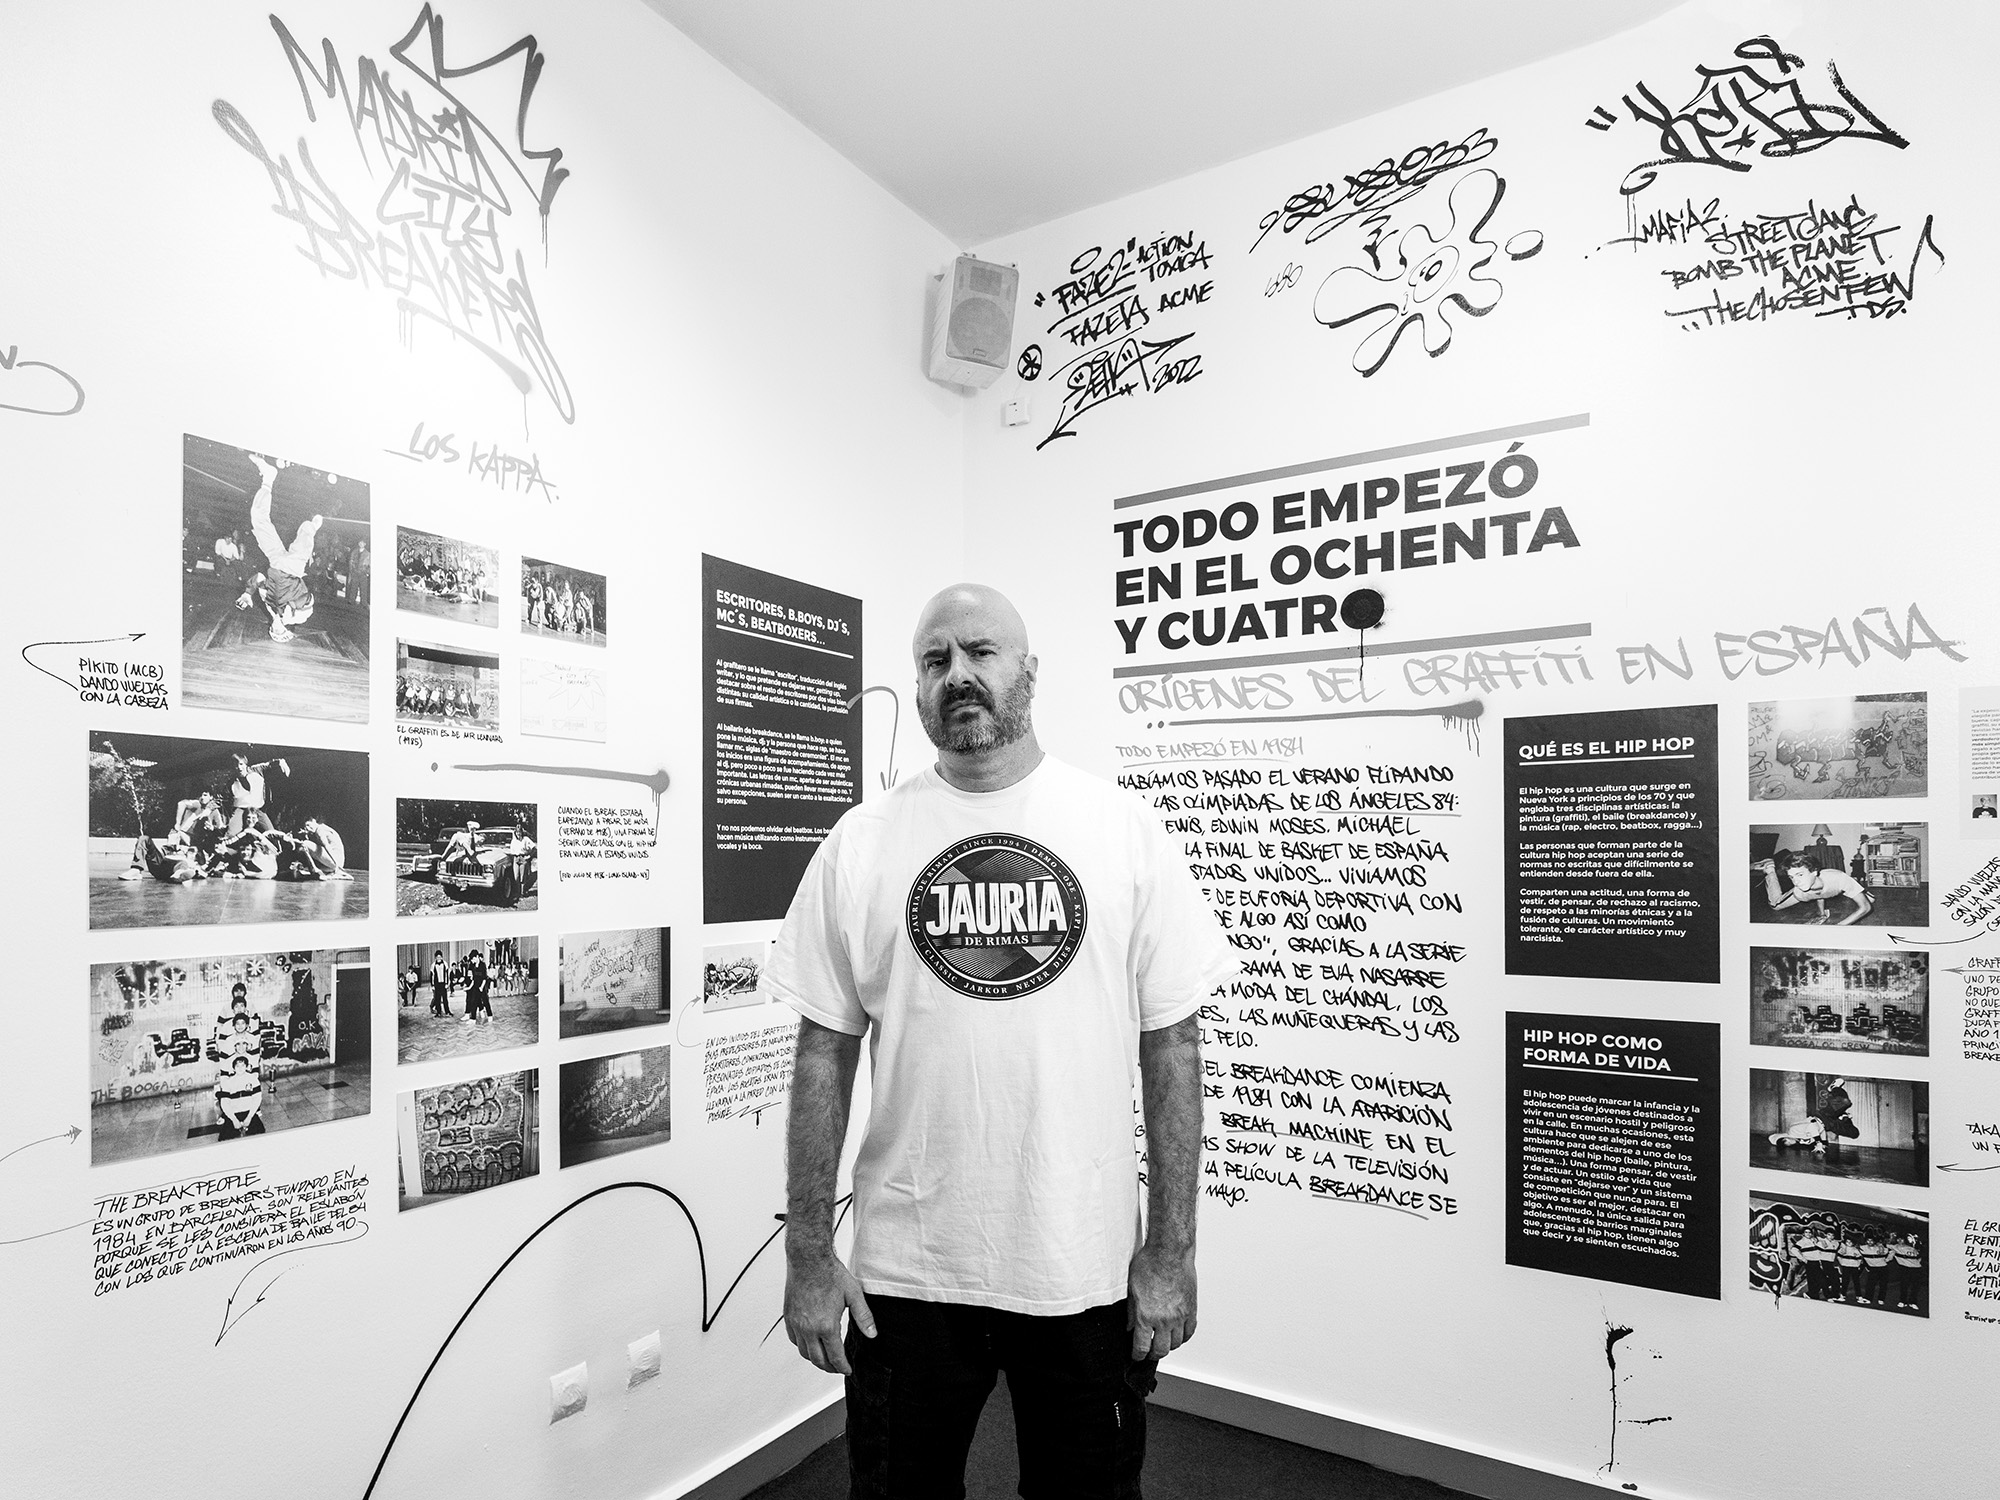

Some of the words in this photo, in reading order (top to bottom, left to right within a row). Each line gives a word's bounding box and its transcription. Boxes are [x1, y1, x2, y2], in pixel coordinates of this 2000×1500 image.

[1157, 280, 1215, 313] ACME
[408, 420, 460, 464] LOS
[1113, 500, 1260, 559] TODO
[1271, 441, 1541, 541] EMPEZÓ
[1114, 561, 1186, 608] EN
[1195, 552, 1259, 596] EL
[1269, 504, 1582, 586] OCHENTA
[716, 589, 787, 620] ESCRITORES,
[788, 608, 826, 629] B.BOYS,
[751, 616, 826, 646] BEATBOXERS...
[1114, 617, 1148, 656] Y
[1315, 665, 1390, 704] DEL
[1617, 642, 1695, 684] EN
[1716, 601, 1971, 679] ESPAÑA
[78, 657, 119, 676] PIKITO
[124, 662, 164, 681] (MCB)
[80, 675, 120, 691] DANDO
[121, 680, 169, 696] VUELTAS
[80, 690, 104, 703] CON
[106, 692, 121, 707] LA
[124, 694, 169, 710] CABEZA
[396, 725, 407, 734] EL
[1230, 740, 1258, 757] EN
[1262, 736, 1304, 757] 1984
[1518, 740, 1557, 760] QUÉ
[1561, 743, 1584, 756] ES
[1589, 741, 1611, 755] EL
[1614, 739, 1647, 753] HIP
[1652, 736, 1695, 751] HOP
[1117, 768, 1200, 791] HABÍAMOS
[1203, 769, 1262, 788] PASADO
[1268, 771, 1291, 787] EL
[1292, 768, 1360, 786] VERANO
[1519, 787, 1528, 795] El
[1529, 786, 1543, 795] hip
[1545, 786, 1563, 795] hop
[1595, 784, 1628, 792] cultura
[1629, 783, 1648, 793] que
[1649, 783, 1677, 792] surge
[1678, 782, 1691, 790] en
[1154, 794, 1181, 811] LAS
[1290, 793, 1312, 811] DE
[1315, 791, 1342, 811] LOS
[1349, 786, 1433, 812] ÁNGELES
[1519, 804, 1554, 814] engloba
[1556, 804, 1574, 812] tres
[1575, 802, 1622, 813] disciplinas
[1624, 801, 1670, 811] artísticas:
[1671, 801, 1680, 809] la
[584, 807, 592, 816] EL
[620, 809, 644, 818] ESTABA
[754, 834, 780, 842] utilizando
[1160, 816, 1207, 836] EWIS,
[962, 838, 994, 850] SINCE
[1031, 847, 1058, 869] DEMO
[1062, 875, 1077, 894] OSE
[912, 895, 921, 933] JAURIA
[918, 879, 928, 892] DE
[927, 852, 954, 878] RIMAS
[925, 881, 1068, 937] JAURIA
[964, 936, 983, 946] DE
[986, 935, 1029, 946] RIMAS
[924, 949, 958, 983] CLASSIC
[963, 982, 1008, 994] JARKOR
[1016, 970, 1051, 991] NEVER
[1053, 945, 1071, 969] DIES
[1963, 975, 1985, 984] UNO
[1965, 985, 1999, 997] GRUPO
[1523, 1029, 1554, 1043] HIP
[1558, 1031, 1598, 1047] HOP
[1601, 1034, 1663, 1051] COMO
[1963, 1027, 1989, 1038] AÑO
[1523, 1047, 1590, 1065] FORMA
[1594, 1053, 1620, 1068] DE
[1624, 1054, 1671, 1072] VIDA
[1230, 1061, 1344, 1089] BREAKDANCE
[1203, 1082, 1225, 1099] DE
[1232, 1085, 1273, 1108] 1984
[1280, 1090, 1312, 1111] CON
[1323, 1096, 1346, 1117] LA
[1204, 1160, 1219, 1177] LA
[1224, 1160, 1303, 1191] PELÍCULA
[1308, 1175, 1424, 1210] BREAKDANCE
[1429, 1193, 1459, 1215] SE
[92, 1221, 115, 1236] ES
[179, 1204, 196, 1218] DE
[198, 1186, 274, 1212] BREAKERS
[274, 1176, 329, 1196] FUNDADO
[334, 1164, 356, 1183] EN
[93, 1196, 130, 1219] THE
[1522, 1228, 1540, 1237] que
[1542, 1228, 1564, 1241] decir
[1565, 1233, 1572, 1243] y
[1573, 1234, 1584, 1243] se
[1585, 1235, 1620, 1249] sienten
[1621, 1242, 1680, 1258] escuchados.
